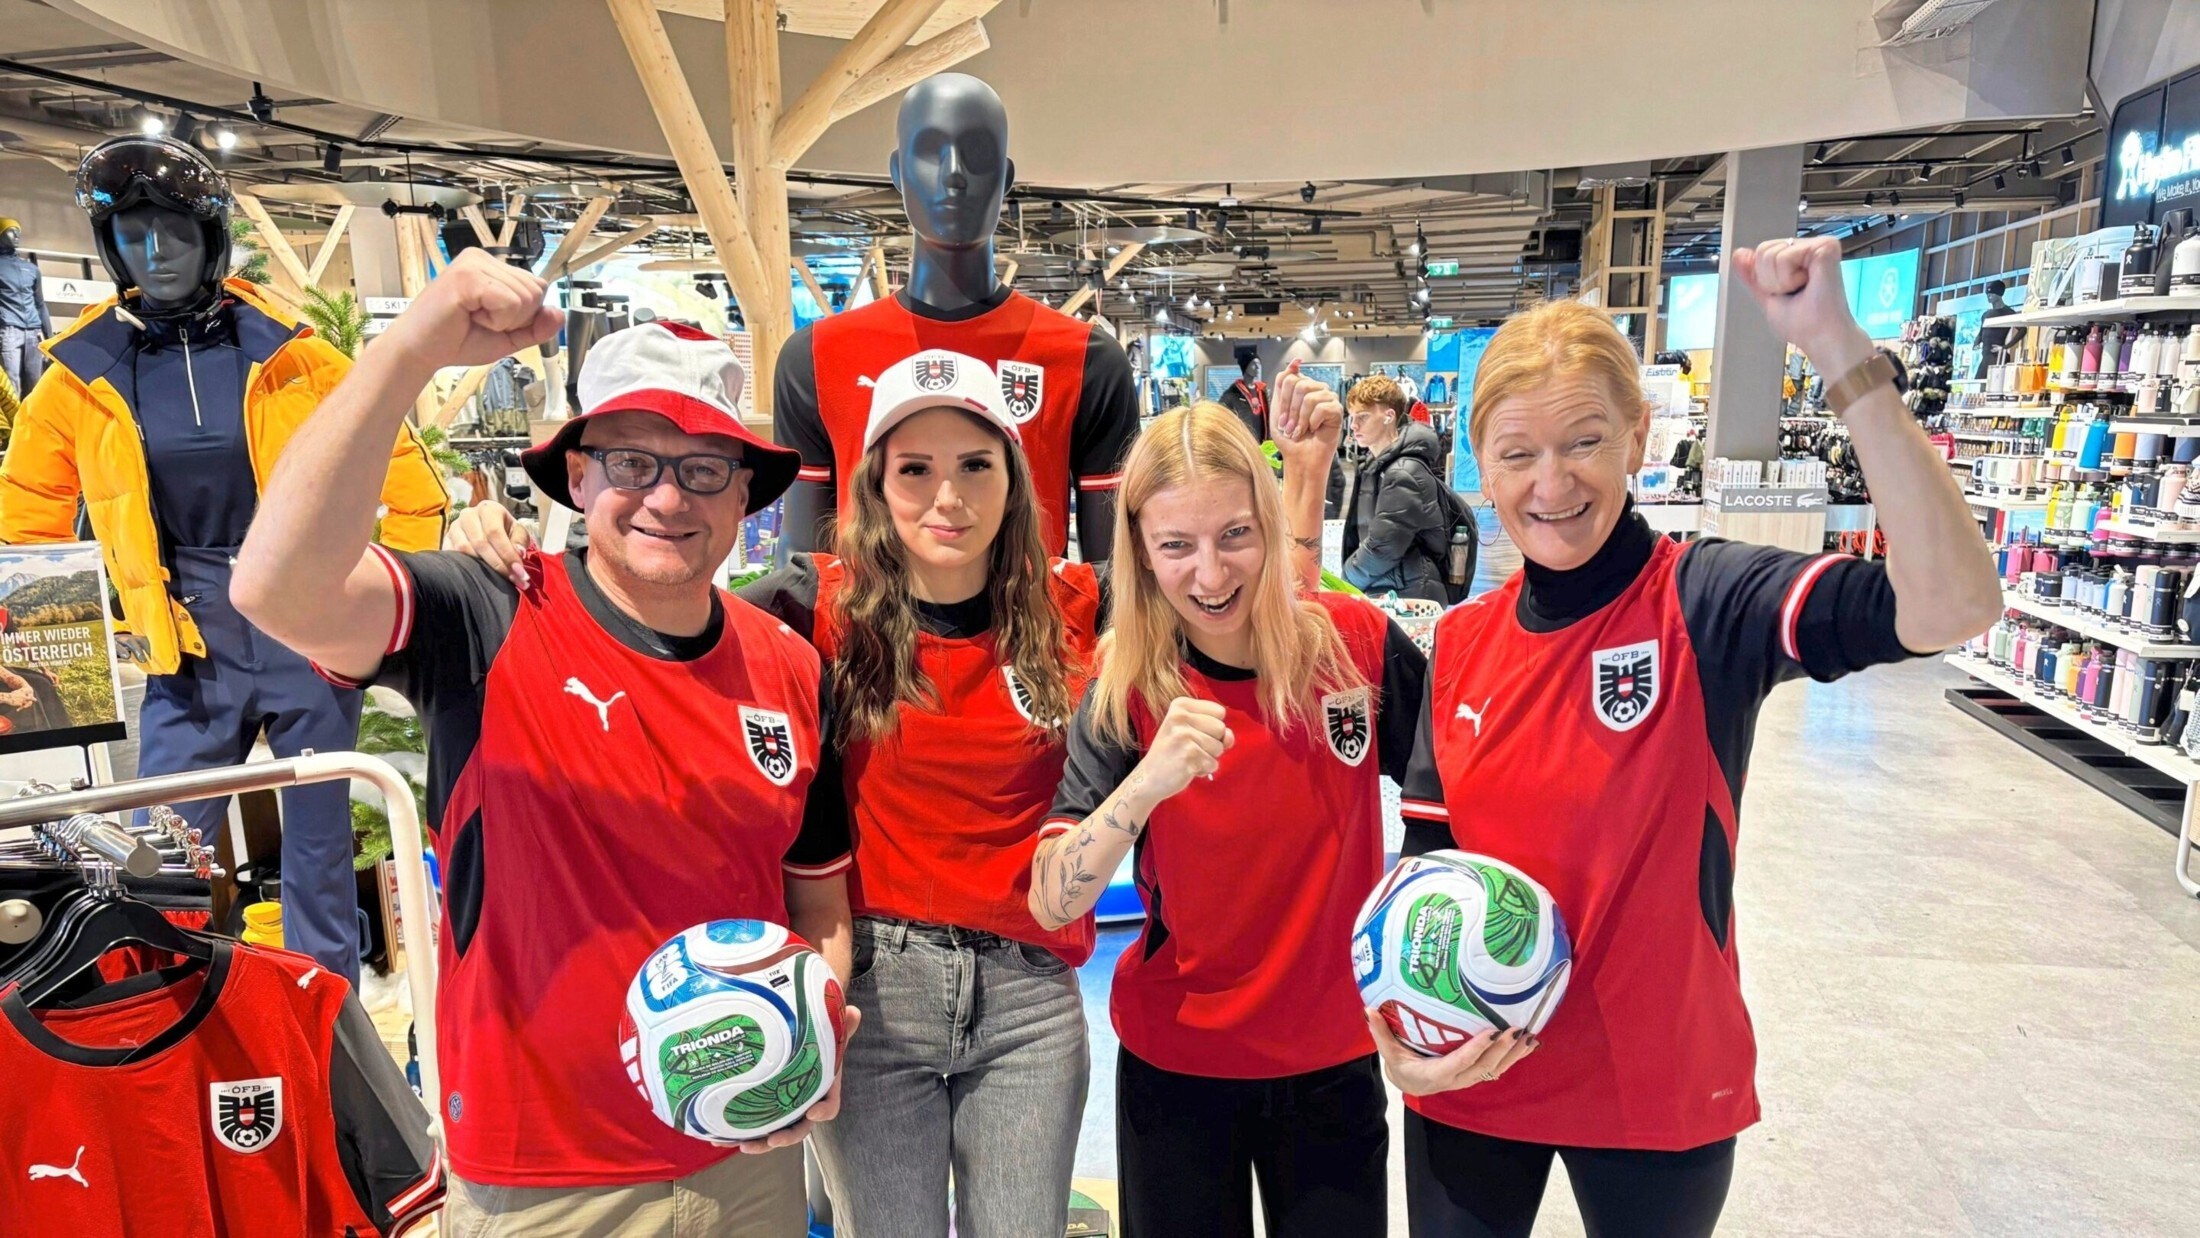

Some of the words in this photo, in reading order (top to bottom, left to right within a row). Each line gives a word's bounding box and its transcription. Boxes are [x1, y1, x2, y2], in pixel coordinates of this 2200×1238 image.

[1725, 495, 1792, 507] LACOSTE
[1, 630, 41, 645] IMMER
[43, 627, 91, 642] WIEDER
[3, 642, 94, 663] ÖSTERREICH
[1612, 651, 1639, 661] ÖFB
[1409, 905, 1429, 975] TRIONDA
[670, 1025, 745, 1056] TRIONDA
[232, 1085, 261, 1094] ÖFB
